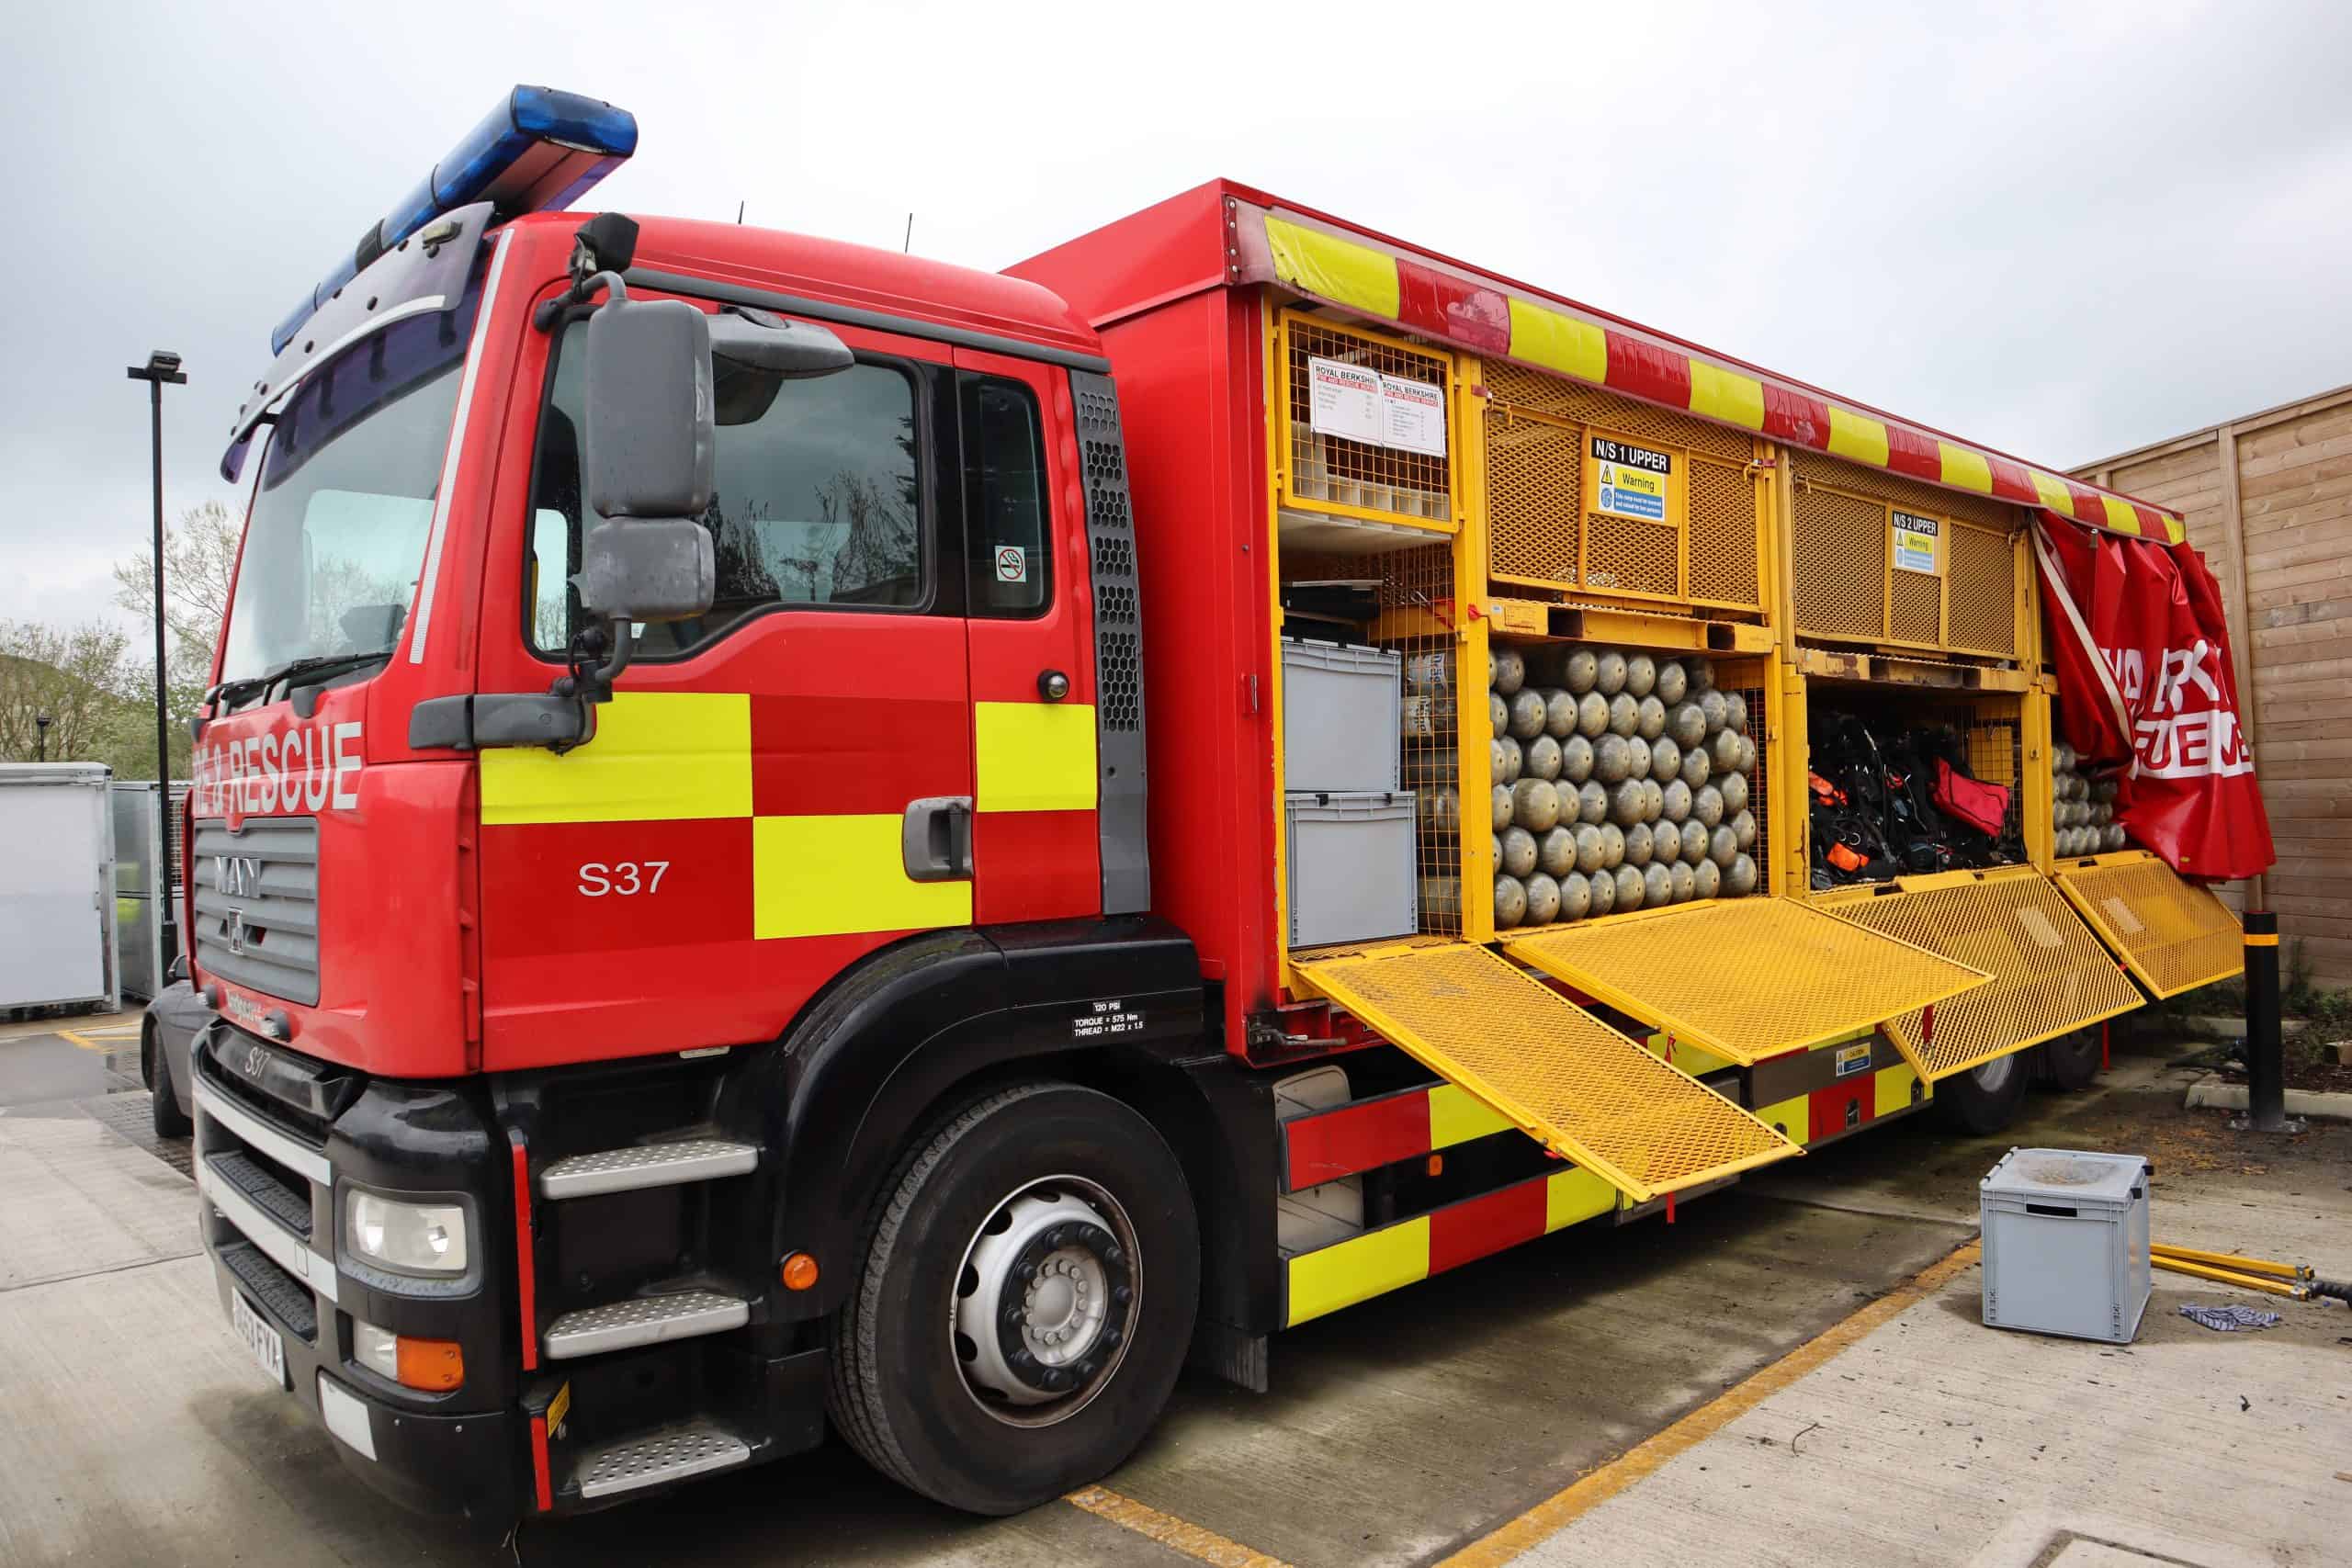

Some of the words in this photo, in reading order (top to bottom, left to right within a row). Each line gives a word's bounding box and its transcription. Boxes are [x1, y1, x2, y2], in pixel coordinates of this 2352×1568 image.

[1316, 367, 1339, 378] ROYAL
[1383, 382, 1403, 393] ROYAL
[1405, 387, 1439, 399] BERKSHIRE
[1596, 440, 1616, 459] N/S
[1620, 446, 1624, 461] 1
[1629, 447, 1668, 470] UPPER
[1623, 473, 1655, 493] Warning
[1894, 513, 1906, 528] N/S
[1907, 517, 1912, 529] 2
[1914, 518, 1937, 535] UPPER
[230, 722, 363, 814] RESCUE
[578, 861, 670, 897] S37
[1108, 1001, 1121, 1010] PSI
[1074, 1017, 1103, 1027] TORQUE
[1126, 1013, 1138, 1021] Nm
[1074, 1026, 1102, 1037] THREAD
[244, 1046, 272, 1077] S37
